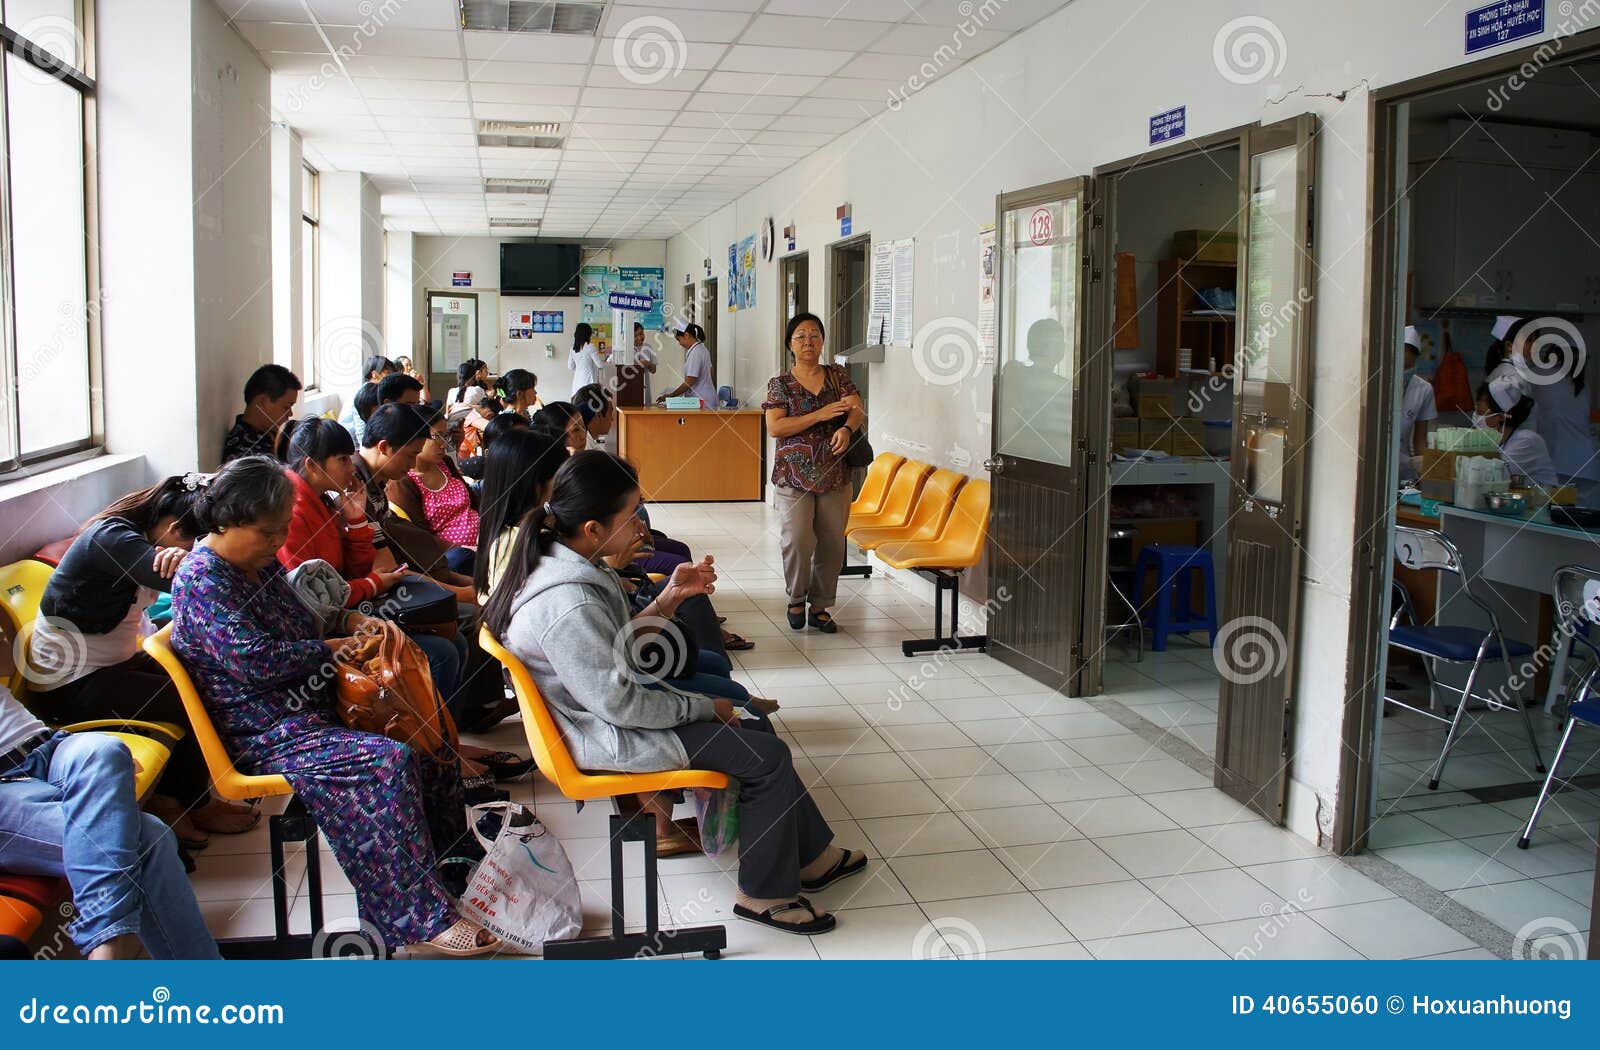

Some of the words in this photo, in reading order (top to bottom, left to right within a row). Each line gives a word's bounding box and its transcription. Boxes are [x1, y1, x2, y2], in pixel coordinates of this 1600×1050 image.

[1478, 26, 1490, 37] SINH
[1497, 29, 1509, 40] 127
[1032, 215, 1050, 240] 128
[1403, 543, 1415, 565] 2
